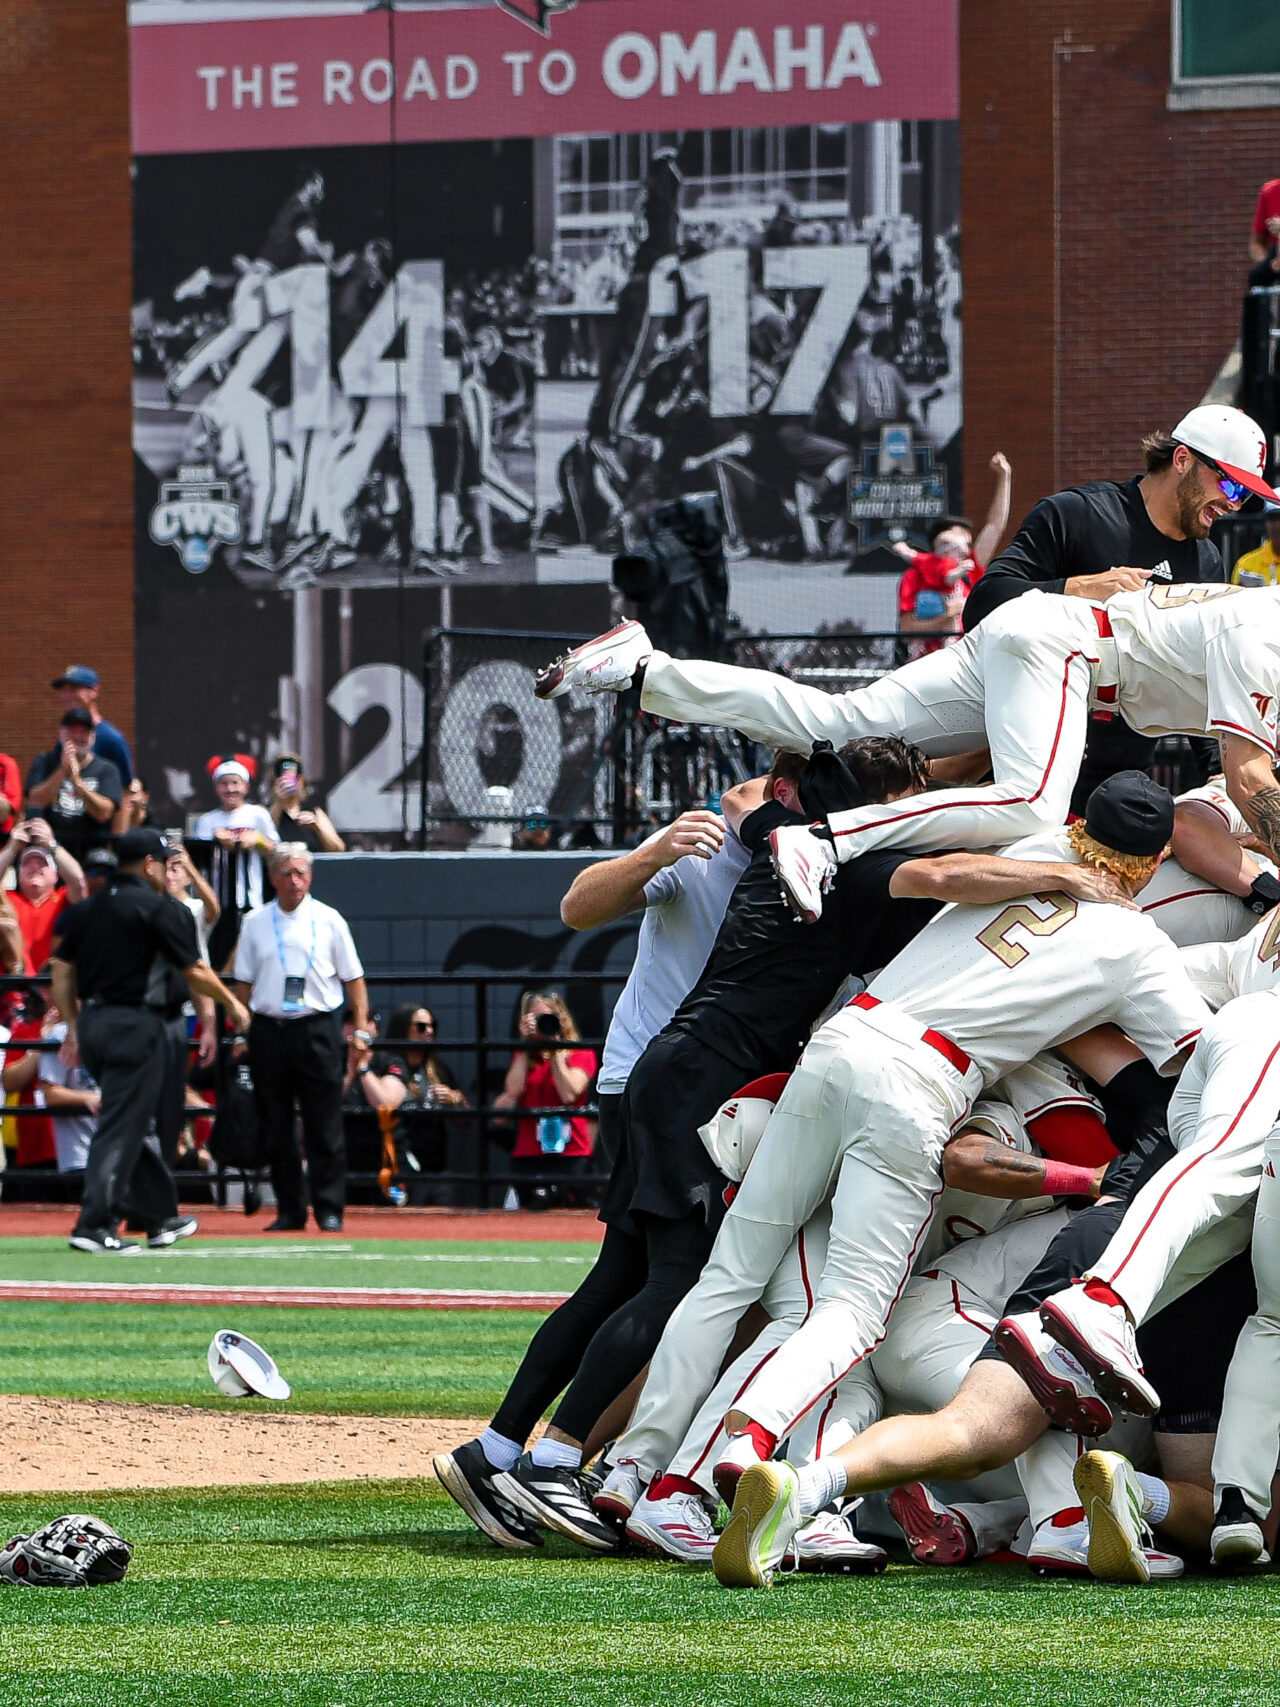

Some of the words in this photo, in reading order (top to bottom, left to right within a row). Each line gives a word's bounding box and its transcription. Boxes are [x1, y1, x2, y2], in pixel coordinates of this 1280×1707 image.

[197, 63, 299, 112] THE
[322, 53, 479, 105] ROAD
[502, 48, 578, 98] TO
[600, 22, 882, 99] OMAHA
[150, 501, 240, 540] CWS
[974, 889, 1080, 970] 2
